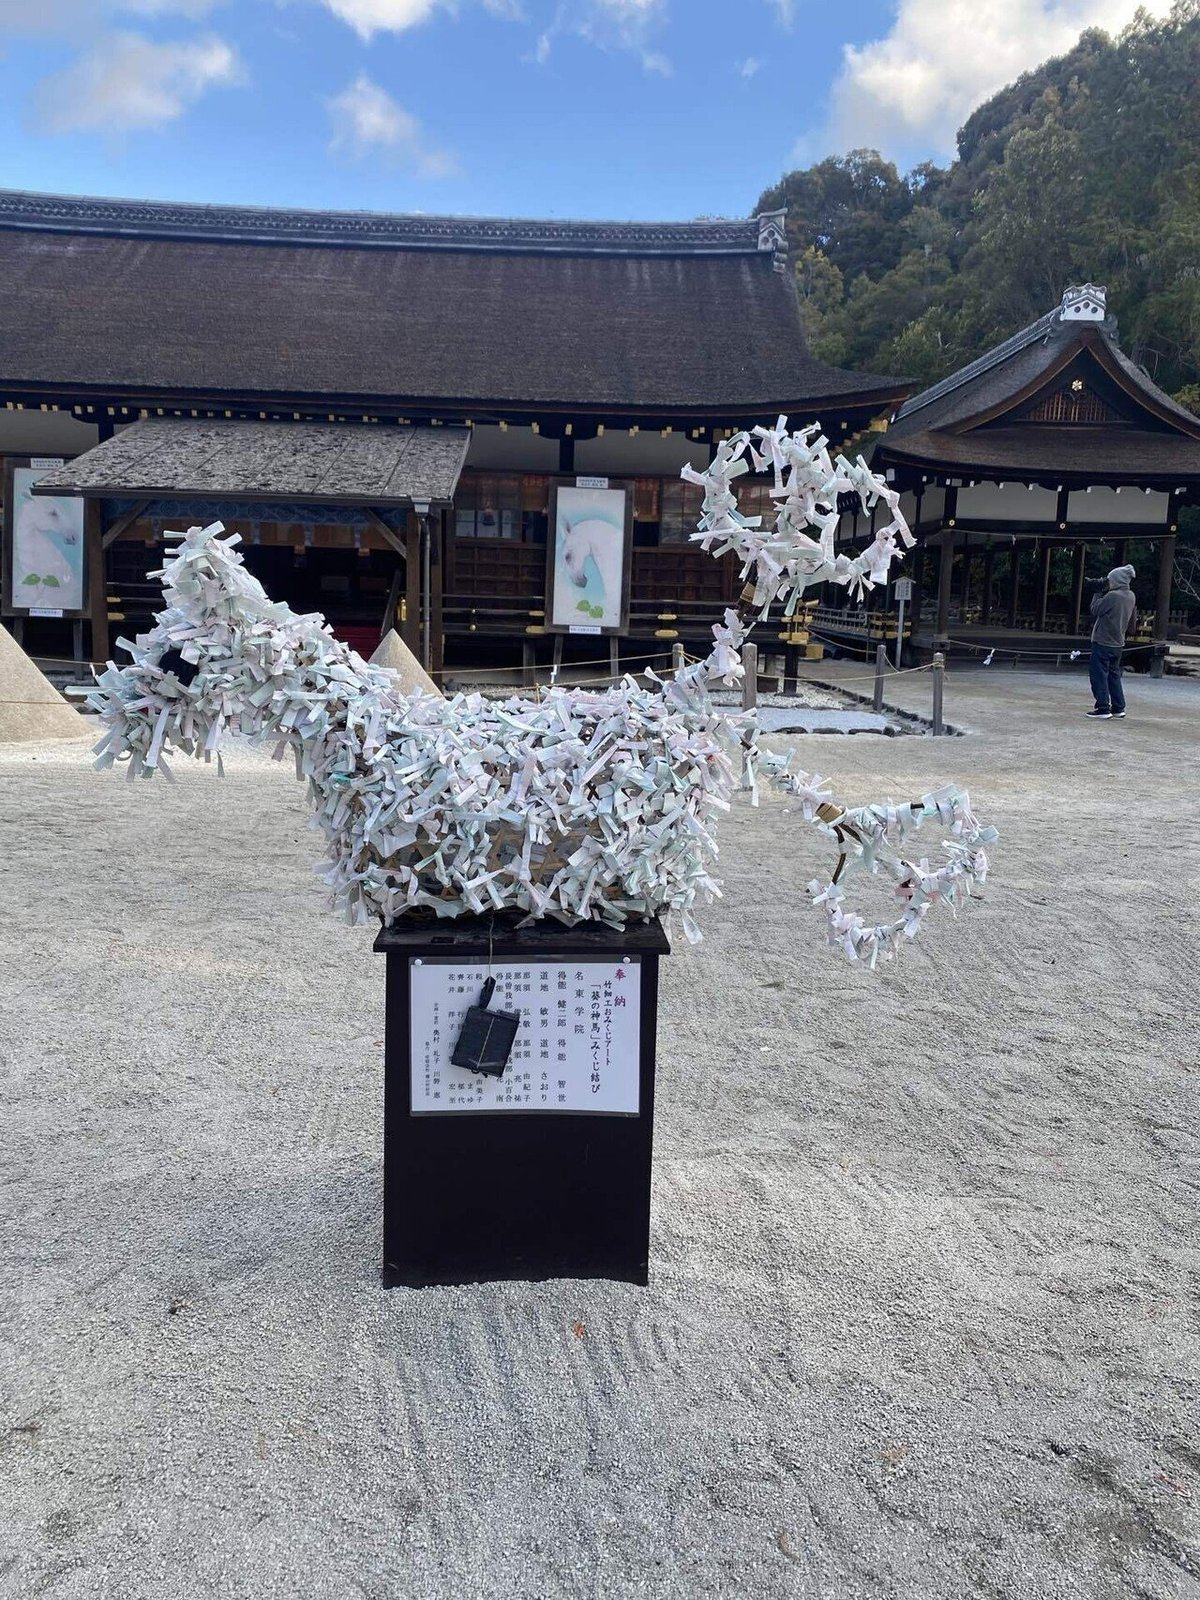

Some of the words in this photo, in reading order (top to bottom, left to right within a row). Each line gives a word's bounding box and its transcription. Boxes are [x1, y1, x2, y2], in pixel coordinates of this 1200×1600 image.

[574, 971, 585, 1034] 名東学院
[614, 967, 626, 1007] 奉納
[590, 984, 601, 1093] 「葵の神馬」みくじ結び
[603, 980, 612, 1066] 竹細工おみくじアート
[540, 1072, 549, 1102] さおり
